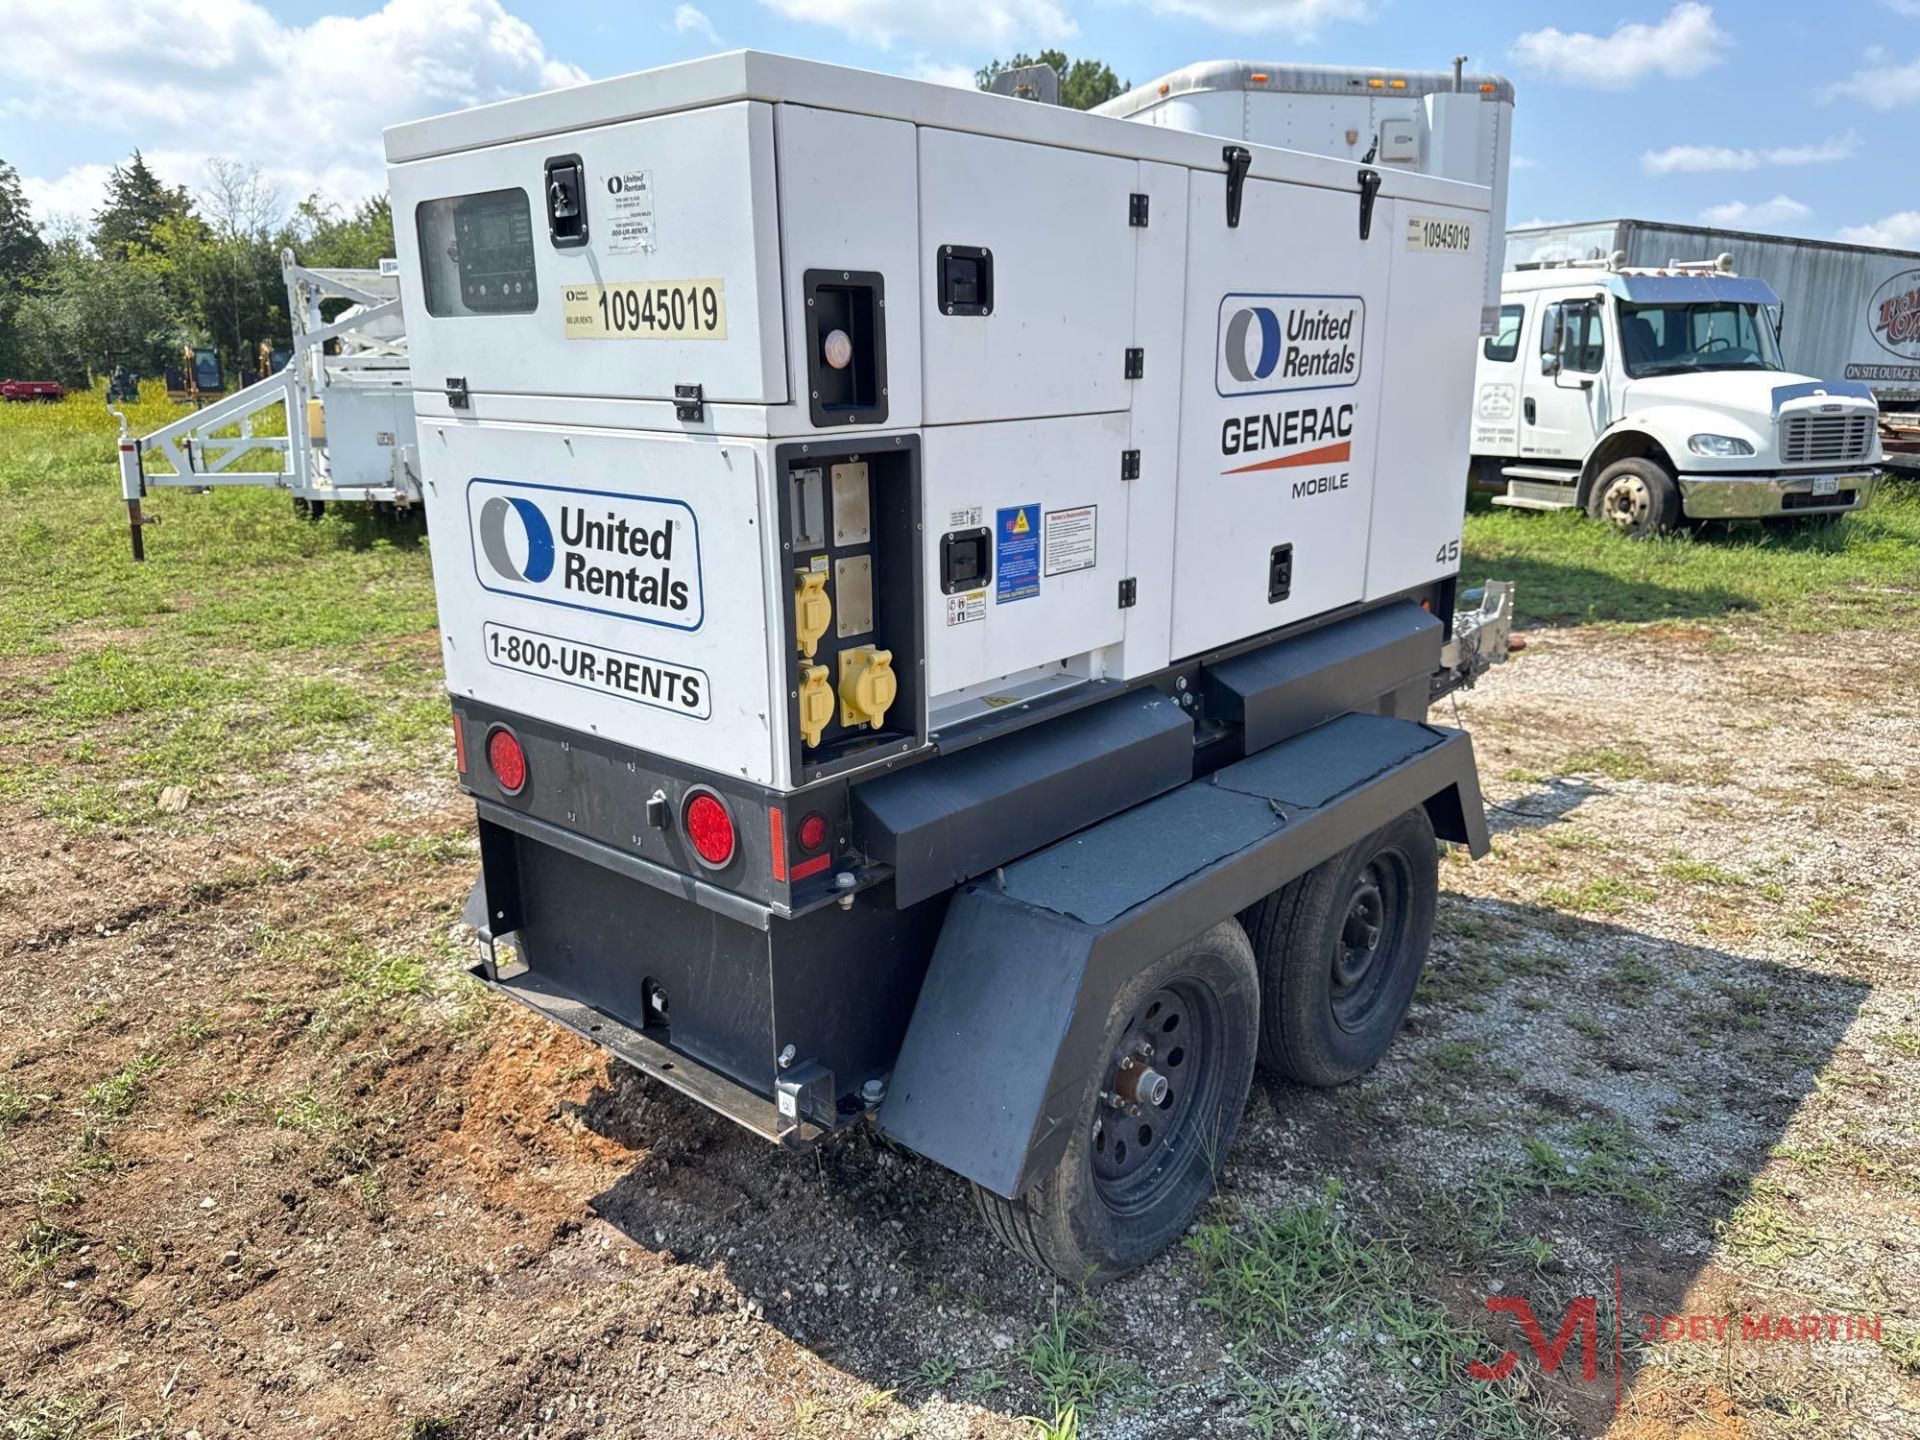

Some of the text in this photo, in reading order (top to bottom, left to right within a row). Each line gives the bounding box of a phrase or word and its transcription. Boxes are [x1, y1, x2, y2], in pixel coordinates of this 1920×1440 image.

[623, 173, 644, 183] United
[624, 183, 646, 192] Rentals
[612, 227, 648, 236] 800-UR-RENTS
[1424, 221, 1470, 250] 10945019
[599, 286, 718, 331] 10945019
[1287, 309, 1354, 341] United
[1283, 344, 1355, 378] Rentals
[1846, 364, 1861, 378] ON
[1861, 365, 1878, 379] SITE
[1879, 366, 1910, 380] OUTAGE
[1222, 404, 1353, 456] GENERAC
[1292, 473, 1349, 499] MOBILE
[561, 506, 673, 561] United
[1436, 540, 1459, 564] 45
[564, 552, 689, 611] Rentals
[490, 632, 700, 708] 1-800-UR-RENTS
